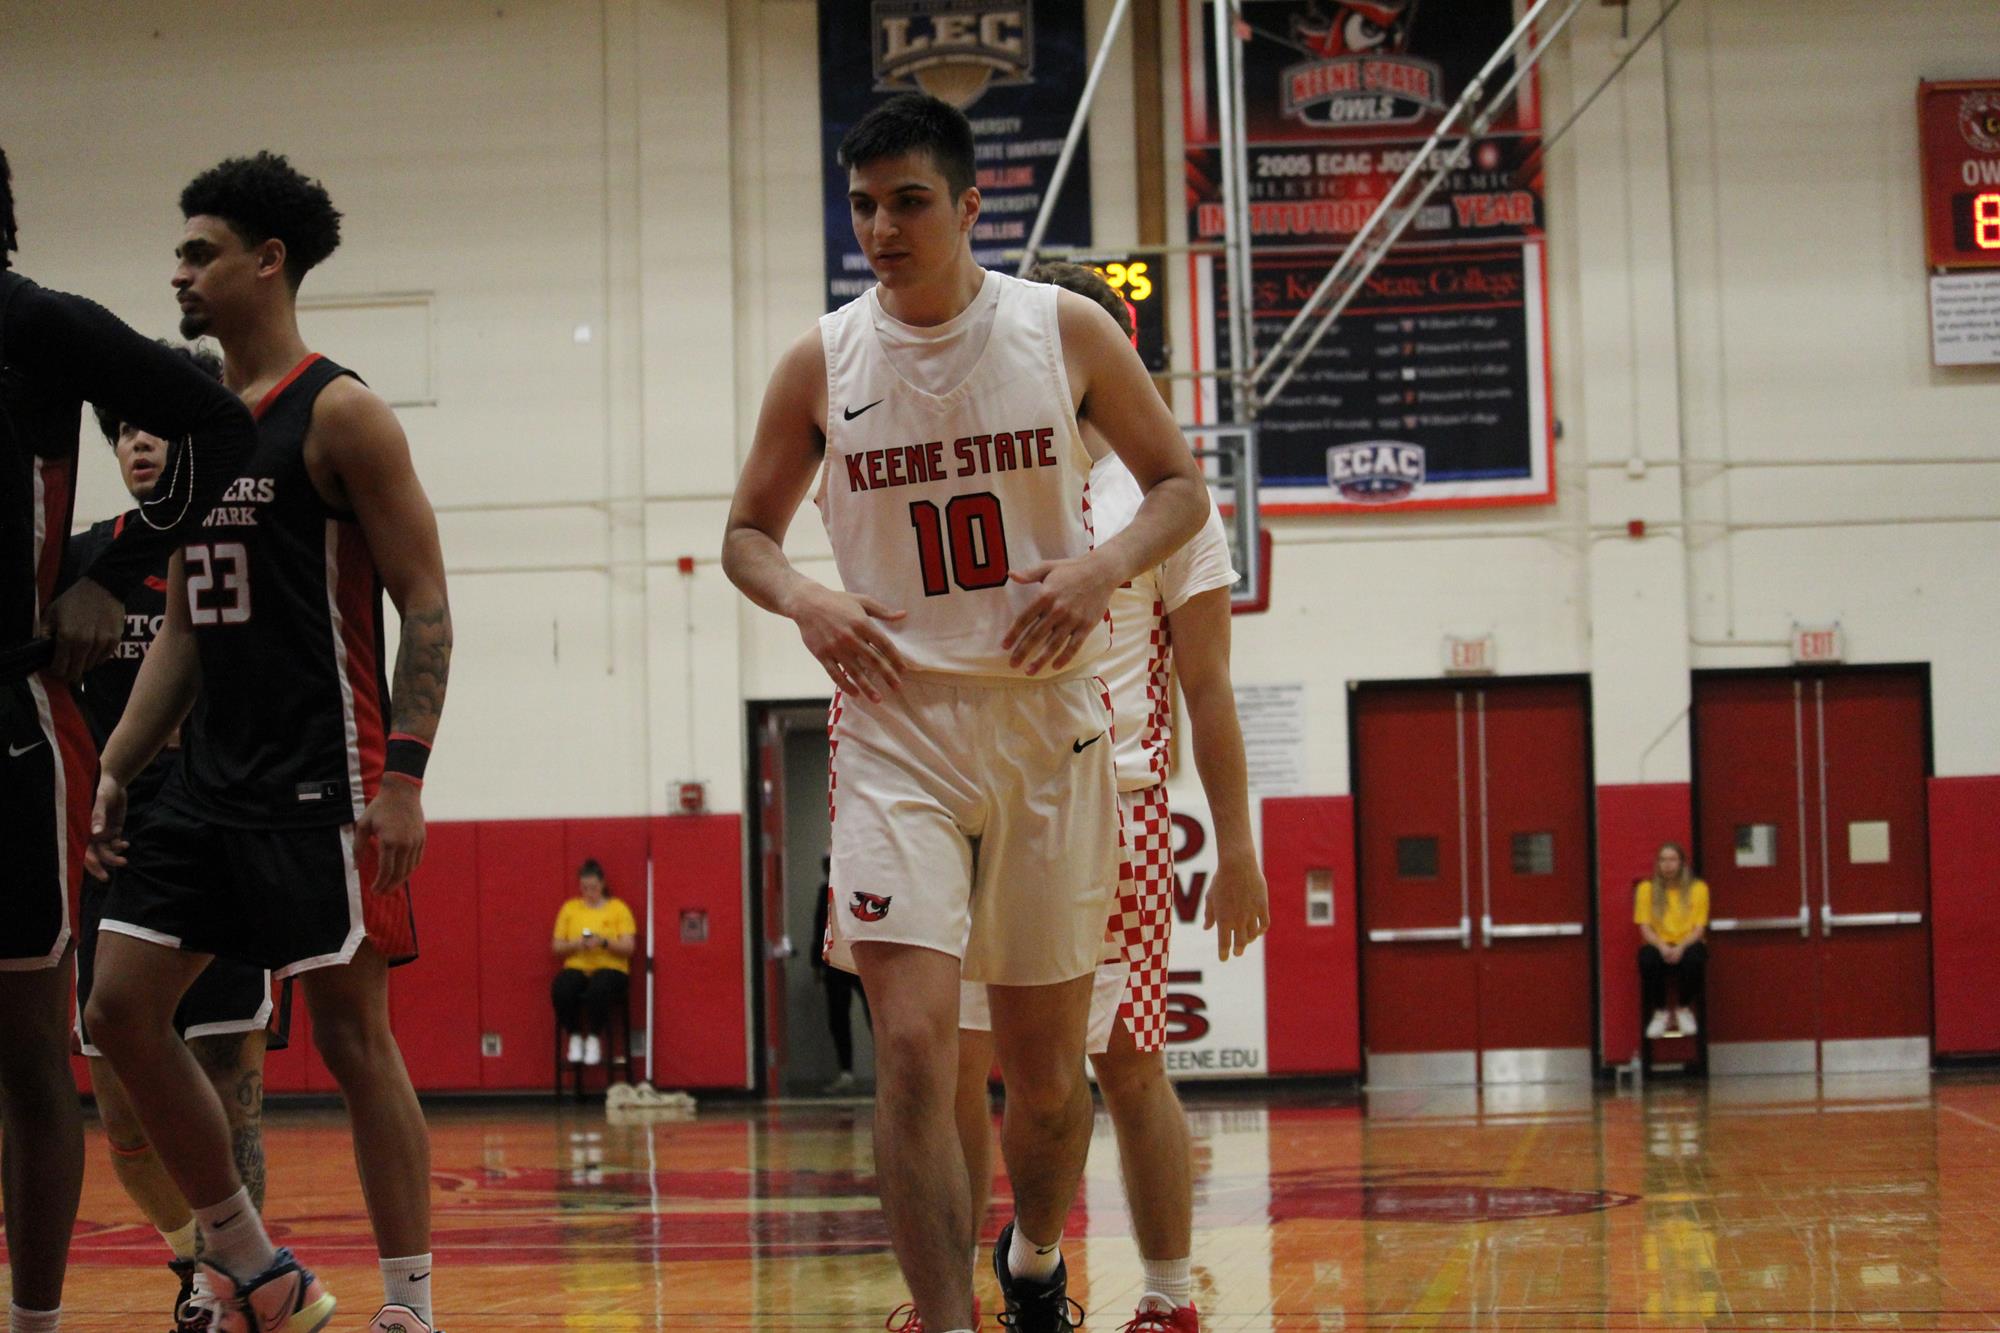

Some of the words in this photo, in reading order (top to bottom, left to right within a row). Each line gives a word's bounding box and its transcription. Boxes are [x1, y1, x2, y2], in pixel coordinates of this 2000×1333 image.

[880, 11, 1024, 62] LEC
[1329, 95, 1395, 122] OWLS
[1316, 152, 1372, 175] ECAC
[1451, 191, 1535, 227] YEAR
[845, 441, 947, 492] KEENE
[953, 427, 1057, 477] STATE
[1333, 447, 1419, 477] ECAC
[909, 491, 1009, 597] 10
[186, 543, 251, 625] 23
[1451, 640, 1486, 666] EXIT
[1800, 631, 1836, 658] EXIT
